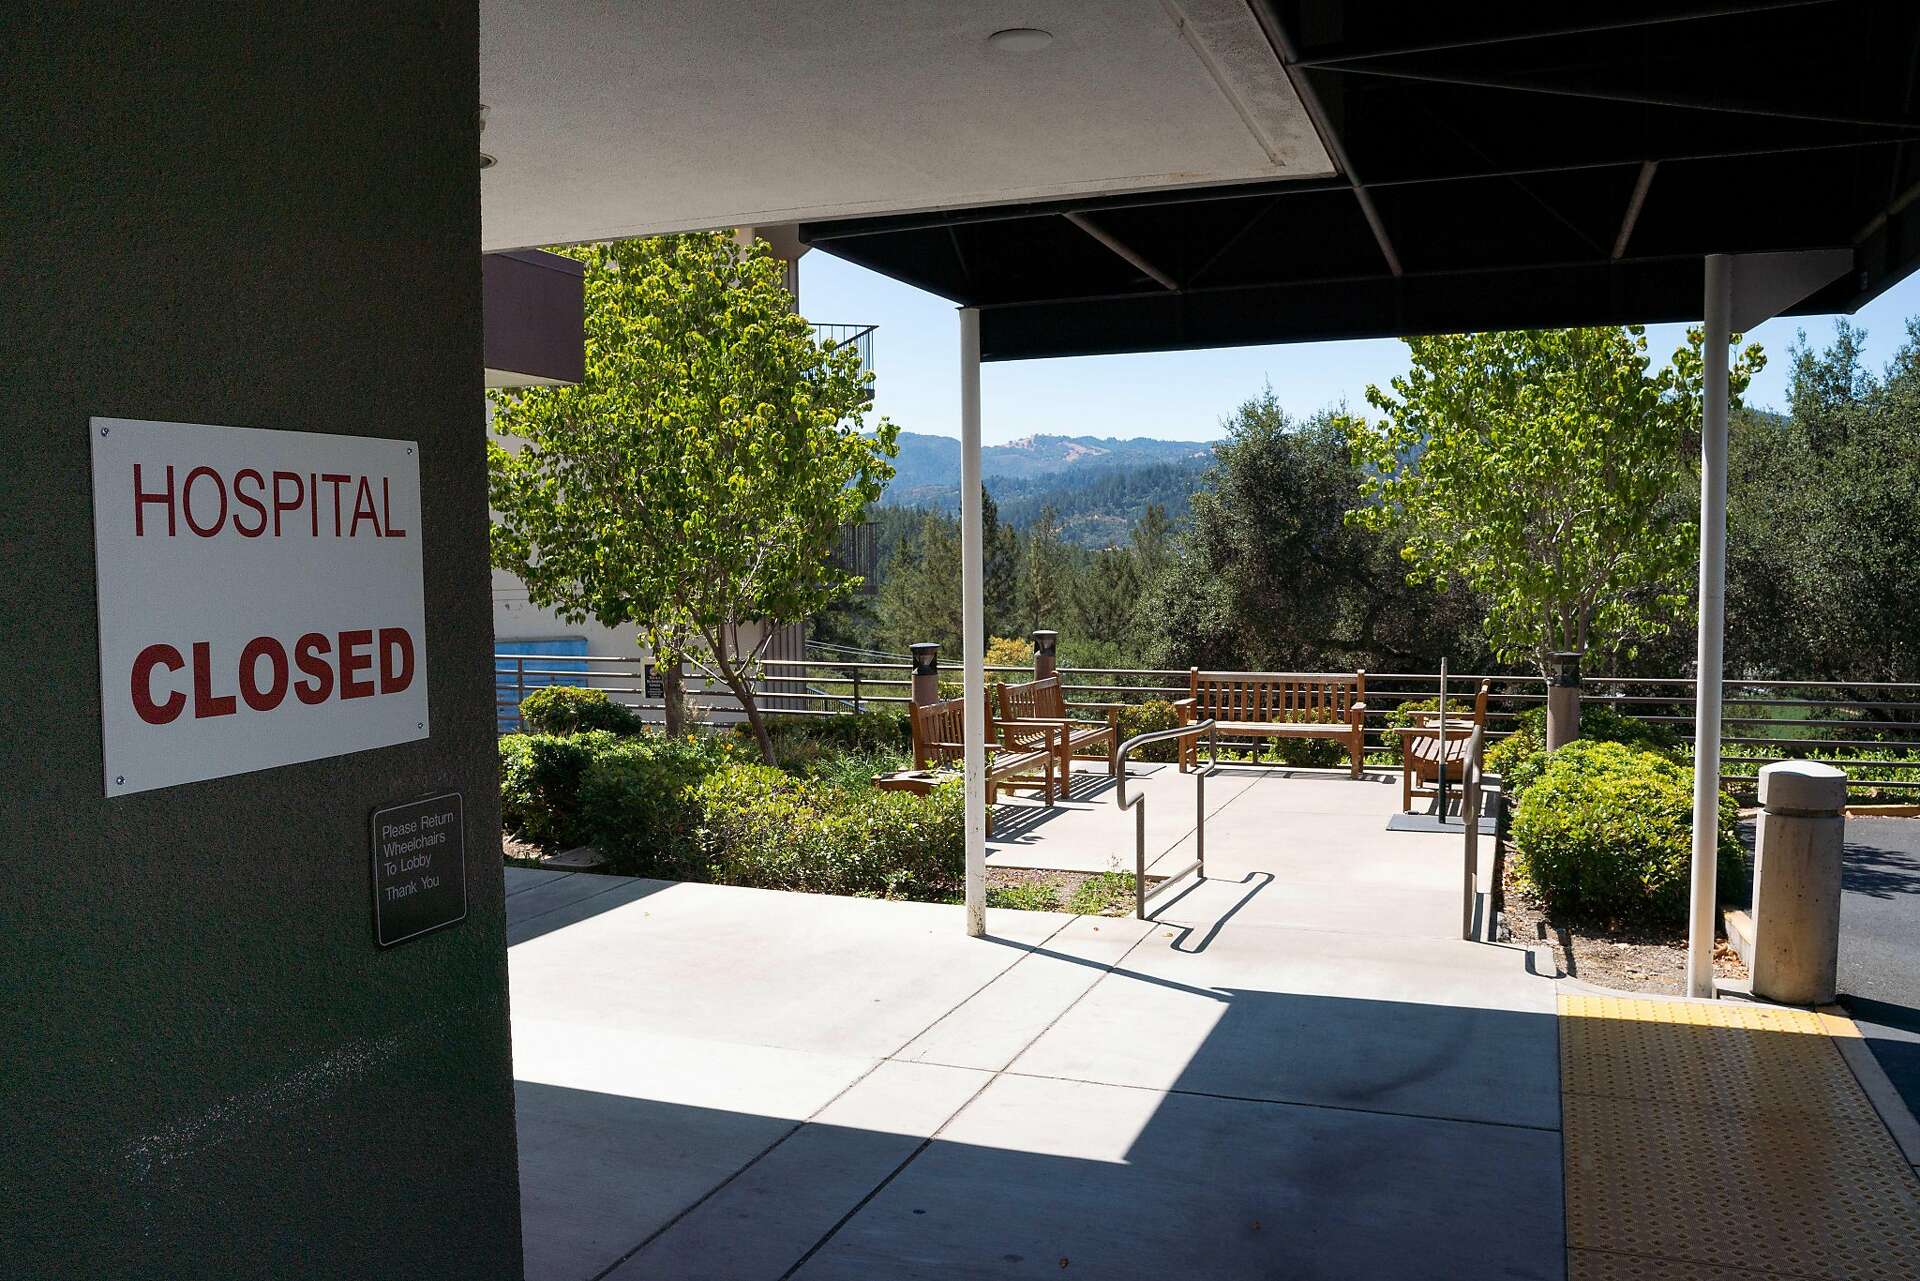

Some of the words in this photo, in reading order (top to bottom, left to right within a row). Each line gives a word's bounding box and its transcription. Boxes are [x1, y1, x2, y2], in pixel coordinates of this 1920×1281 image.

[133, 463, 406, 539] HOSPITAL
[130, 627, 415, 725] CLOSED
[382, 821, 417, 839] Please
[421, 812, 454, 830] Return
[383, 832, 446, 858] Wheelchairs
[384, 862, 397, 877] To
[400, 853, 432, 872] Lobby
[385, 881, 417, 901] Thank
[420, 875, 440, 890] You
